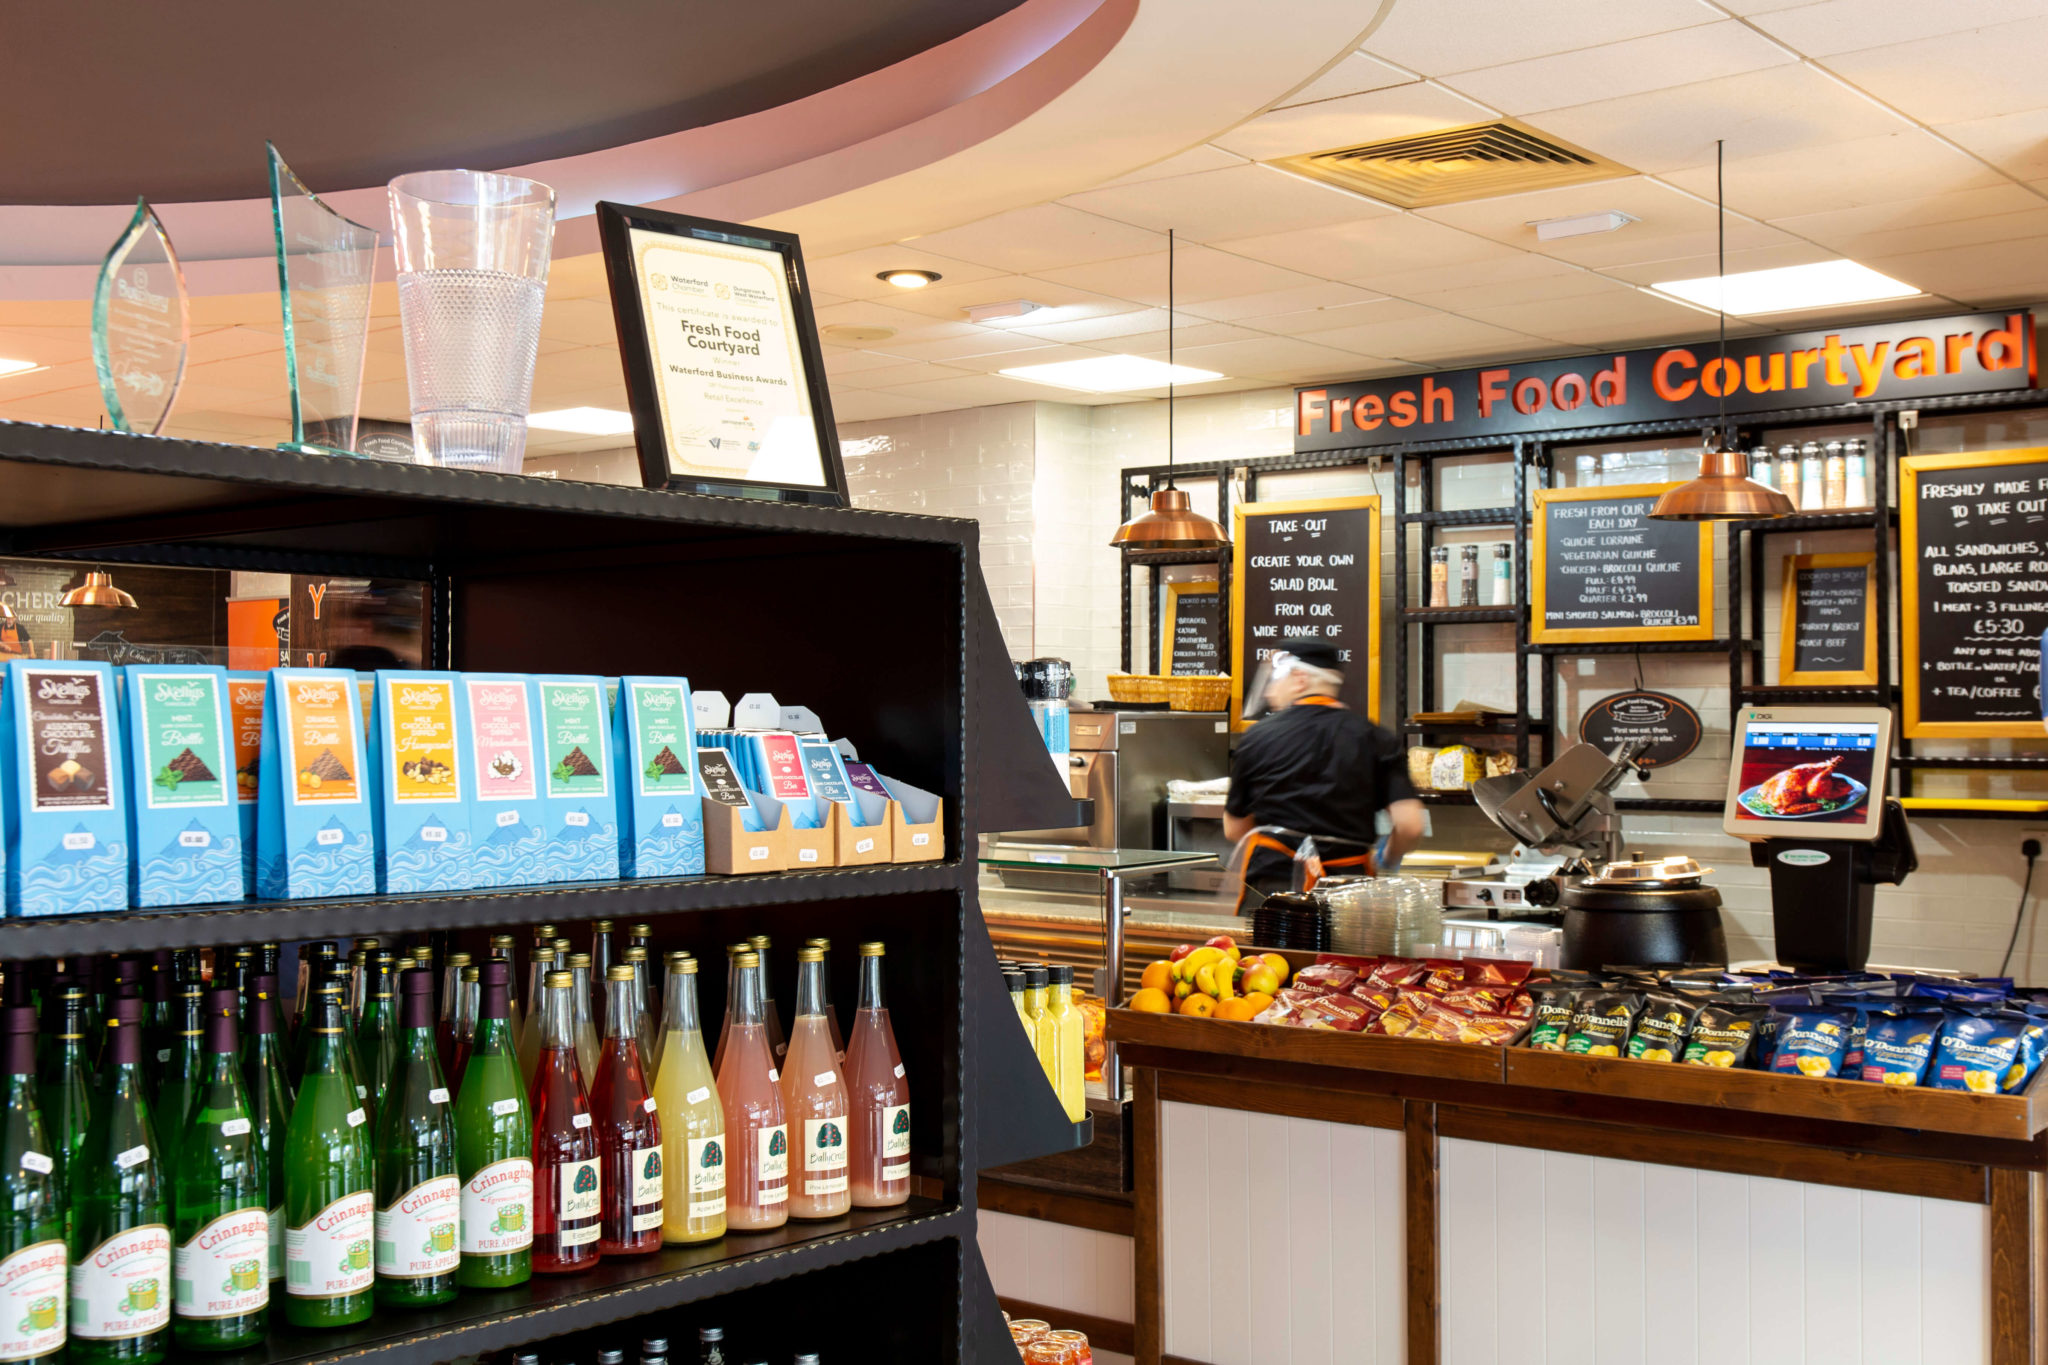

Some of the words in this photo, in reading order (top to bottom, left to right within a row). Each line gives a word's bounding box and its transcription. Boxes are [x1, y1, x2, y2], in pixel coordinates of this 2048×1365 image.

[670, 275, 709, 287] Waterford
[681, 319, 722, 339] Fresh
[724, 325, 761, 342] Food
[687, 335, 761, 356] Courtyard
[669, 364, 714, 378] Waterford
[716, 370, 754, 383] Business
[756, 376, 788, 387] Awards
[1298, 377, 1455, 437] Fresh
[1477, 355, 1628, 418] Food
[1651, 313, 2025, 402] Courtyard
[1921, 483, 1985, 499] FRESHLY
[1993, 480, 2030, 494] MADE
[1554, 507, 1588, 519] FRESH
[1591, 505, 1618, 516] FROM
[1621, 503, 1644, 516] OUR
[1975, 501, 2011, 516] TAKE
[2016, 498, 2048, 513] OUT
[1269, 520, 1298, 533] TAKE
[1589, 519, 1615, 529] EACH
[1618, 518, 1638, 528] DAY
[1601, 534, 1644, 545] LORRAINE
[1563, 552, 1619, 561] VEGETARIAN
[1622, 549, 1657, 559] QUICHE
[1924, 546, 1950, 558] ALL
[1955, 541, 2045, 557] SANDWICHES,
[1251, 555, 1291, 568] CREATE
[1296, 555, 1324, 567] YOUR
[1329, 554, 1354, 567] OWN
[1602, 564, 1642, 573] BROCCOLI
[1646, 562, 1681, 572] QUICHE
[1980, 561, 2023, 574] LARGE
[1270, 577, 1304, 591] SALAD
[1307, 577, 1338, 592] BOWL
[1947, 581, 2001, 593] TOASTED
[309, 583, 327, 620] Y
[1942, 602, 1972, 612] MEAT
[1986, 601, 1998, 614] 3
[1275, 603, 1304, 616] FROM
[1310, 603, 1334, 616] OUR
[1546, 612, 1564, 620] MINI
[1565, 611, 1599, 620] SMOKED
[1601, 610, 1634, 619] SALMON
[1640, 609, 1679, 618] BROCCOLI
[35, 612, 65, 624] quality
[1643, 617, 1674, 626] QUICHE
[1253, 625, 1278, 637] WIDE
[1284, 625, 1319, 637] RANGE
[1326, 625, 1342, 637] OF
[1953, 647, 1976, 655] ANY
[1978, 648, 1992, 656] OF
[1995, 648, 2014, 656] THE
[1936, 661, 1974, 671] BOTTLE
[171, 714, 193, 722] MINT
[305, 716, 336, 724] ORANGE
[401, 722, 445, 730] CHOCOLATE
[482, 722, 520, 730] CHOCOLATE
[41, 730, 96, 738] CHOCOLATE
[1864, 1039, 1928, 1058] O'Donnells
[1941, 1036, 2012, 1062] O'Donnells
[478, 1239, 499, 1249] PURE
[501, 1235, 521, 1247] APPLE
[410, 1260, 431, 1271] PURE
[434, 1255, 454, 1268] APPLE
[326, 1279, 349, 1290] PURE
[208, 1301, 231, 1312] PURE
[235, 1295, 258, 1309] APPLE
[104, 1321, 129, 1332] PURE
